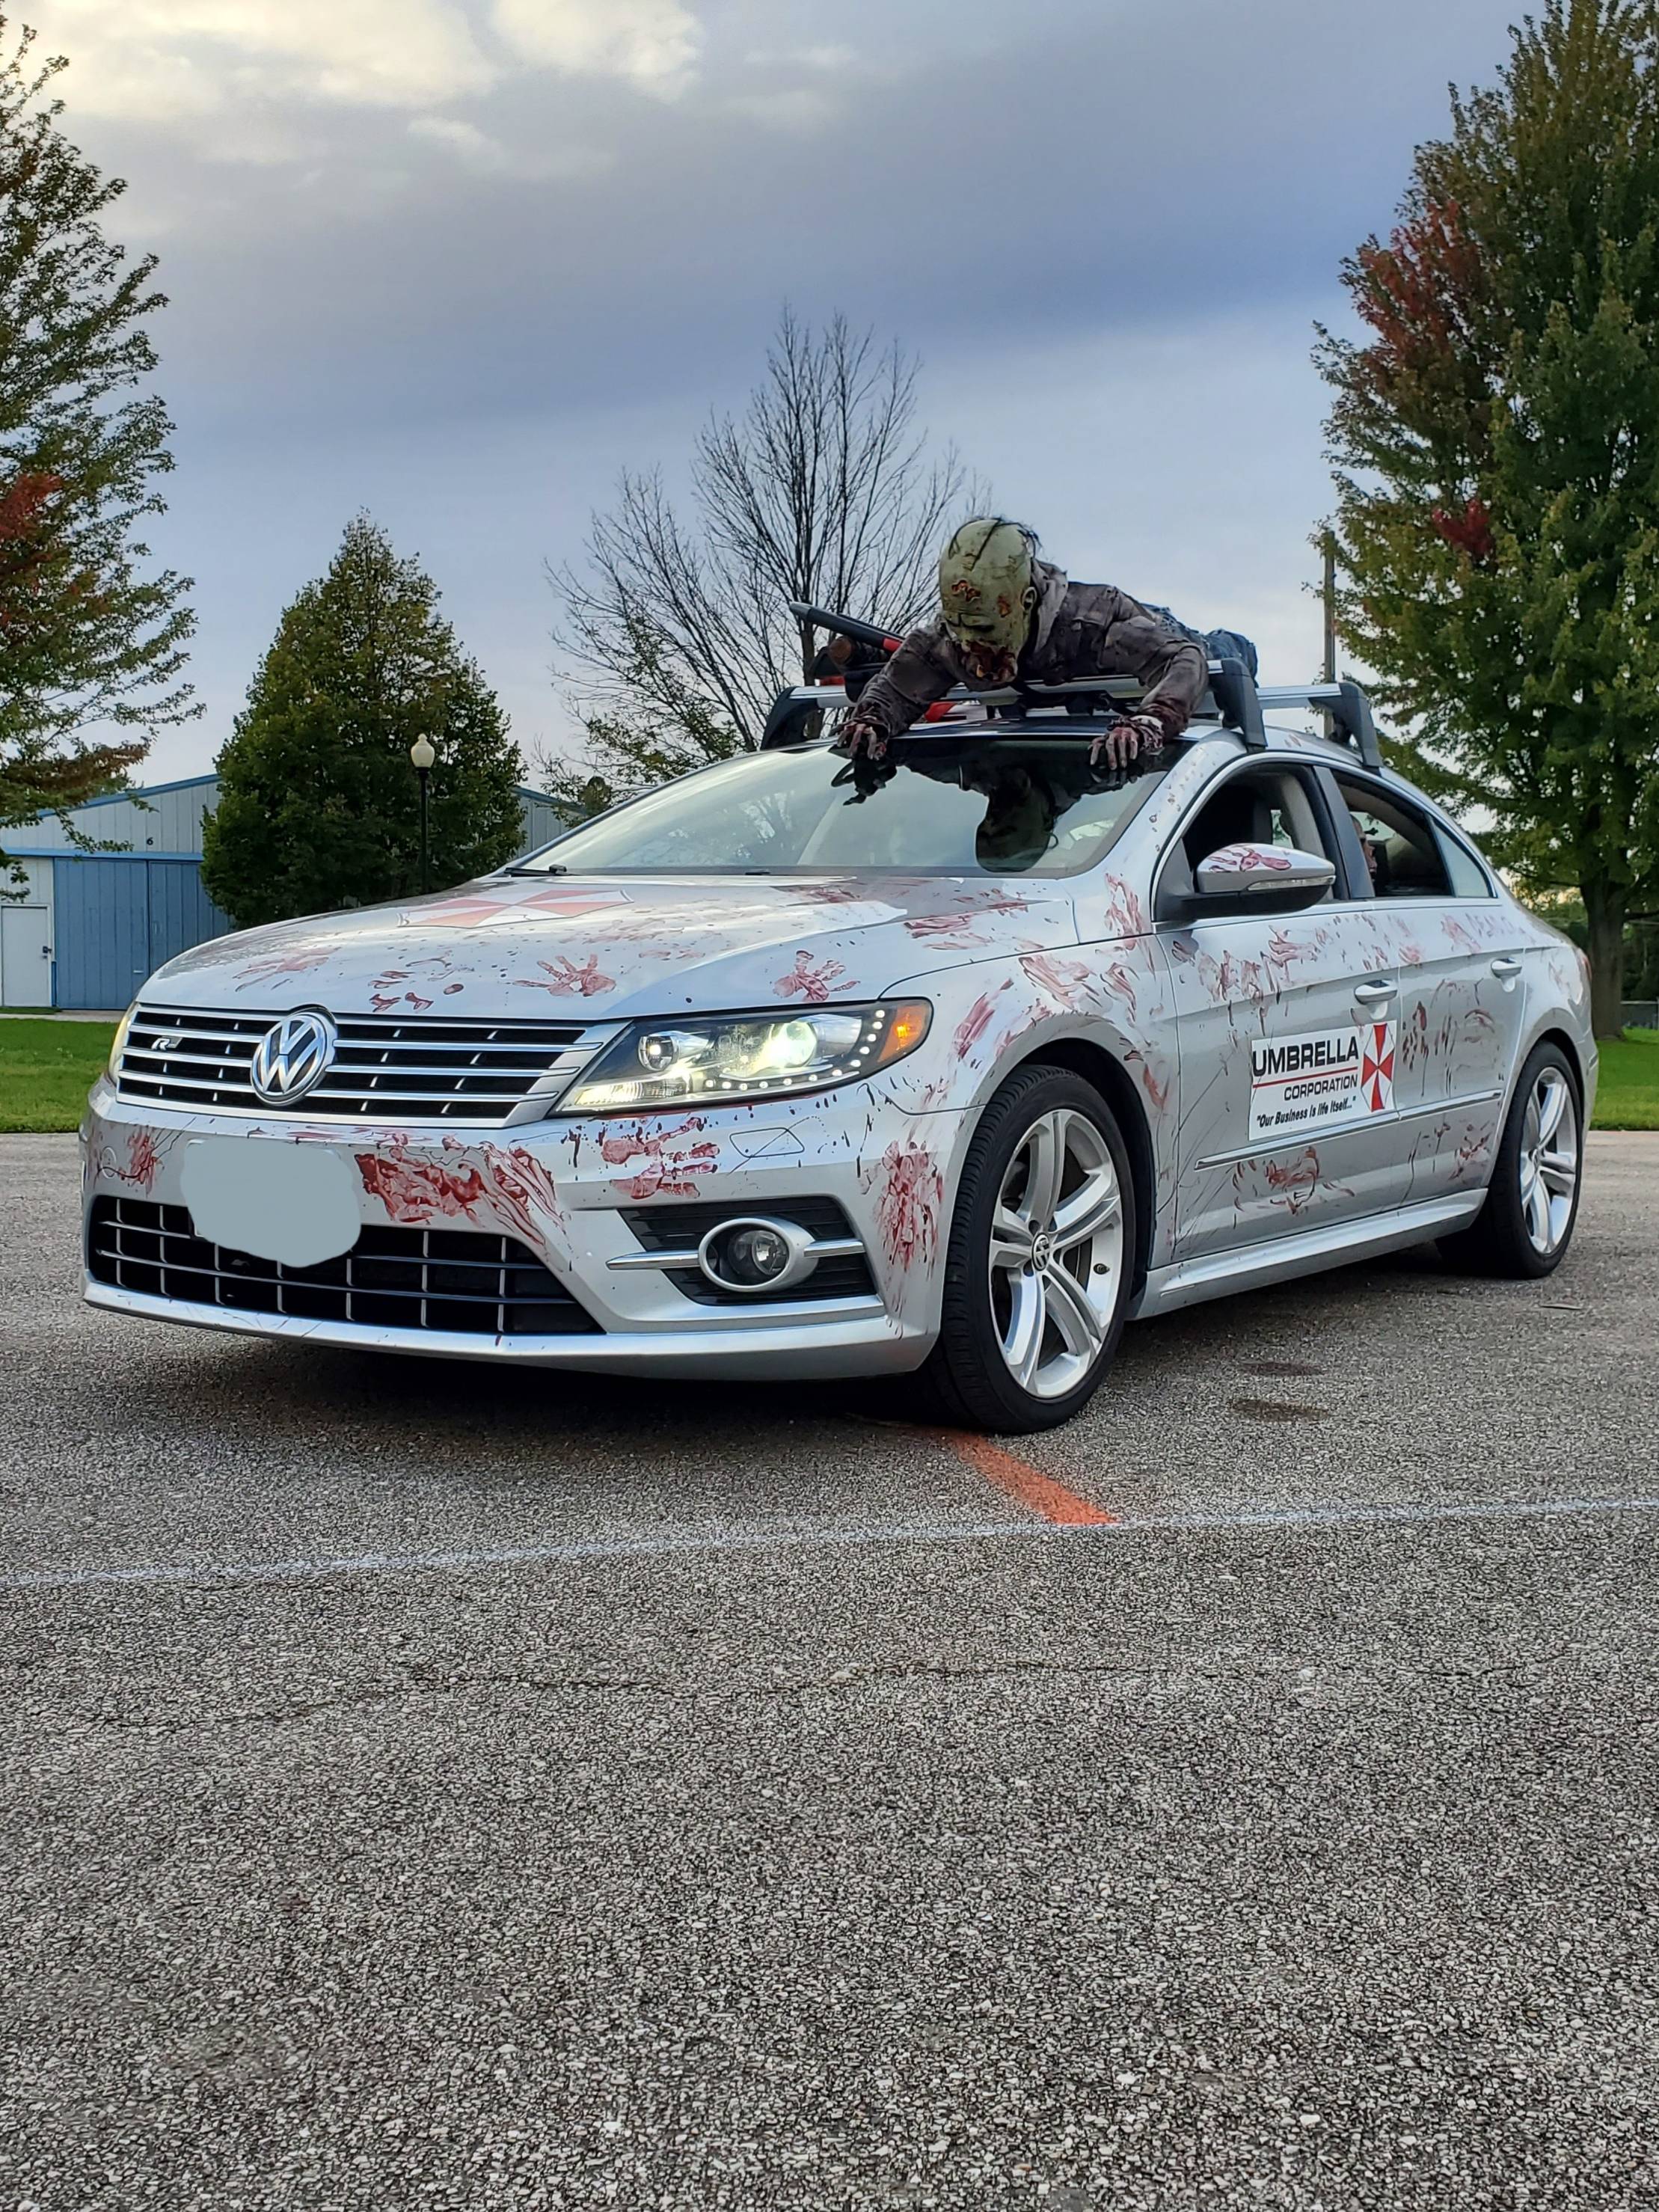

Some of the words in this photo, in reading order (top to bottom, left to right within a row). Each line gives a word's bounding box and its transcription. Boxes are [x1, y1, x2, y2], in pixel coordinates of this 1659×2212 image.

[147, 836, 153, 846] 6
[254, 1015, 327, 1100] VW
[1252, 1036, 1359, 1077] UMBRELLA
[1284, 1074, 1358, 1101] CORPORATION
[1257, 1114, 1274, 1128] "Our
[1275, 1108, 1307, 1125] Business
